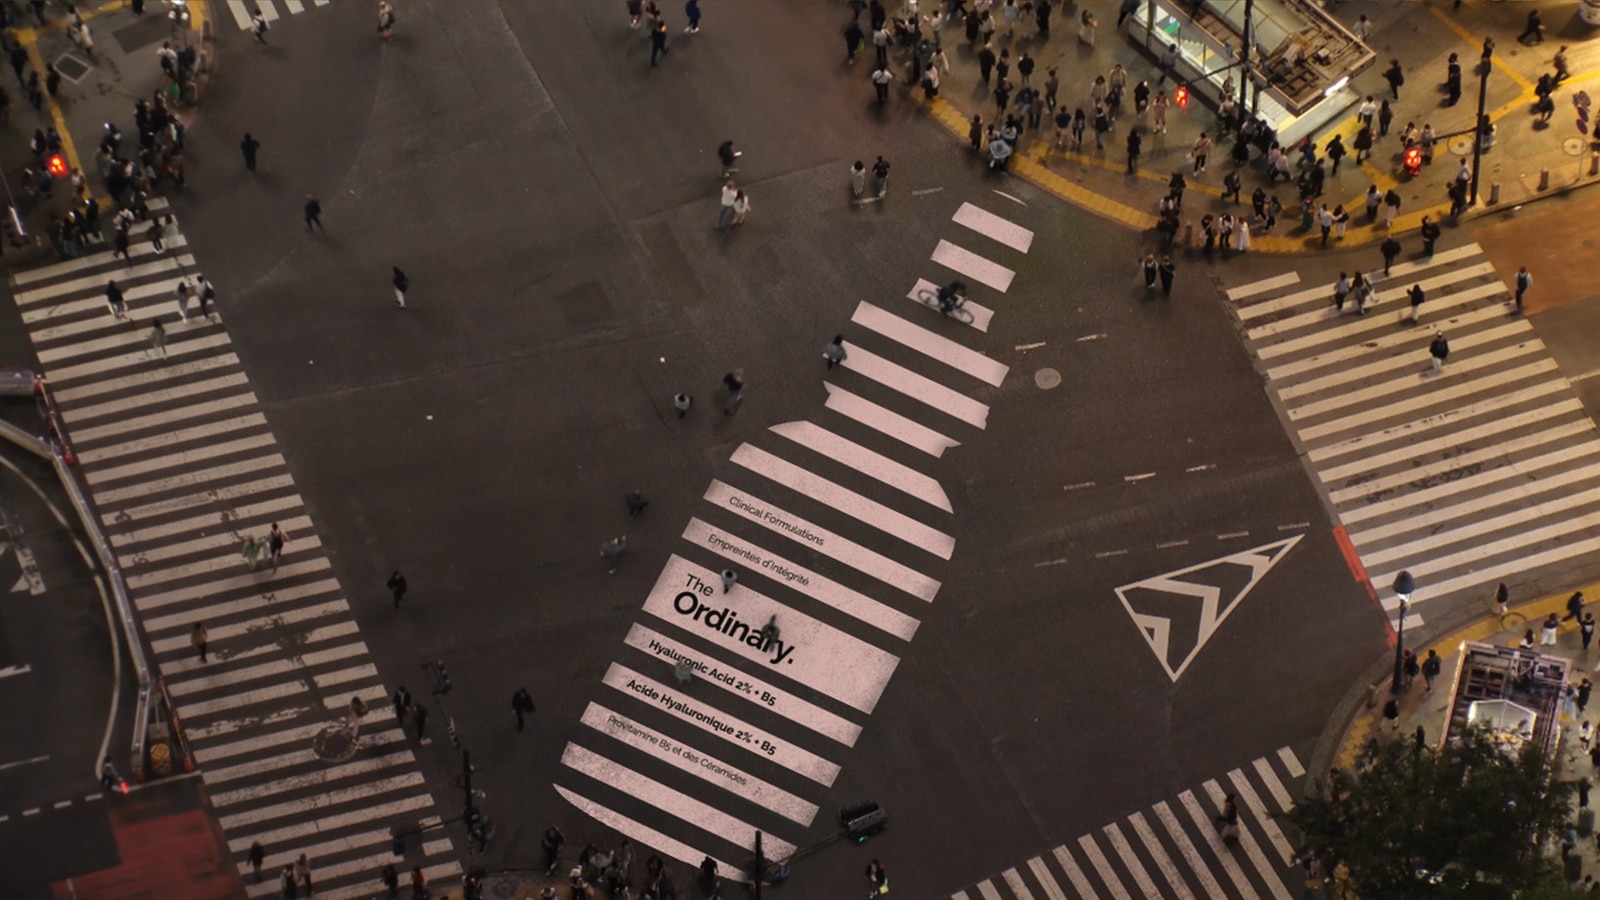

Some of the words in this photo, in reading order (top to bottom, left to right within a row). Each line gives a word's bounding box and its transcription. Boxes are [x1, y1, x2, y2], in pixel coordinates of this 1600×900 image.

[708, 533, 762, 565] Empreintes
[729, 496, 763, 518] Clinical
[763, 512, 825, 546] Formulations
[686, 573, 714, 597] The
[673, 591, 796, 665] Ordinary.
[648, 639, 709, 674] Hyaluronic
[708, 668, 736, 686] Acid
[735, 681, 754, 695] 2%
[760, 691, 778, 707] B5
[606, 715, 659, 745] Provitamine
[658, 738, 673, 752] B5
[671, 746, 683, 757] et
[682, 751, 700, 764] des
[700, 758, 748, 786] Céramides
[626, 679, 660, 700] Acide
[660, 693, 735, 735] Hyaluronique
[735, 730, 754, 744] 2%
[760, 740, 778, 756] B5
